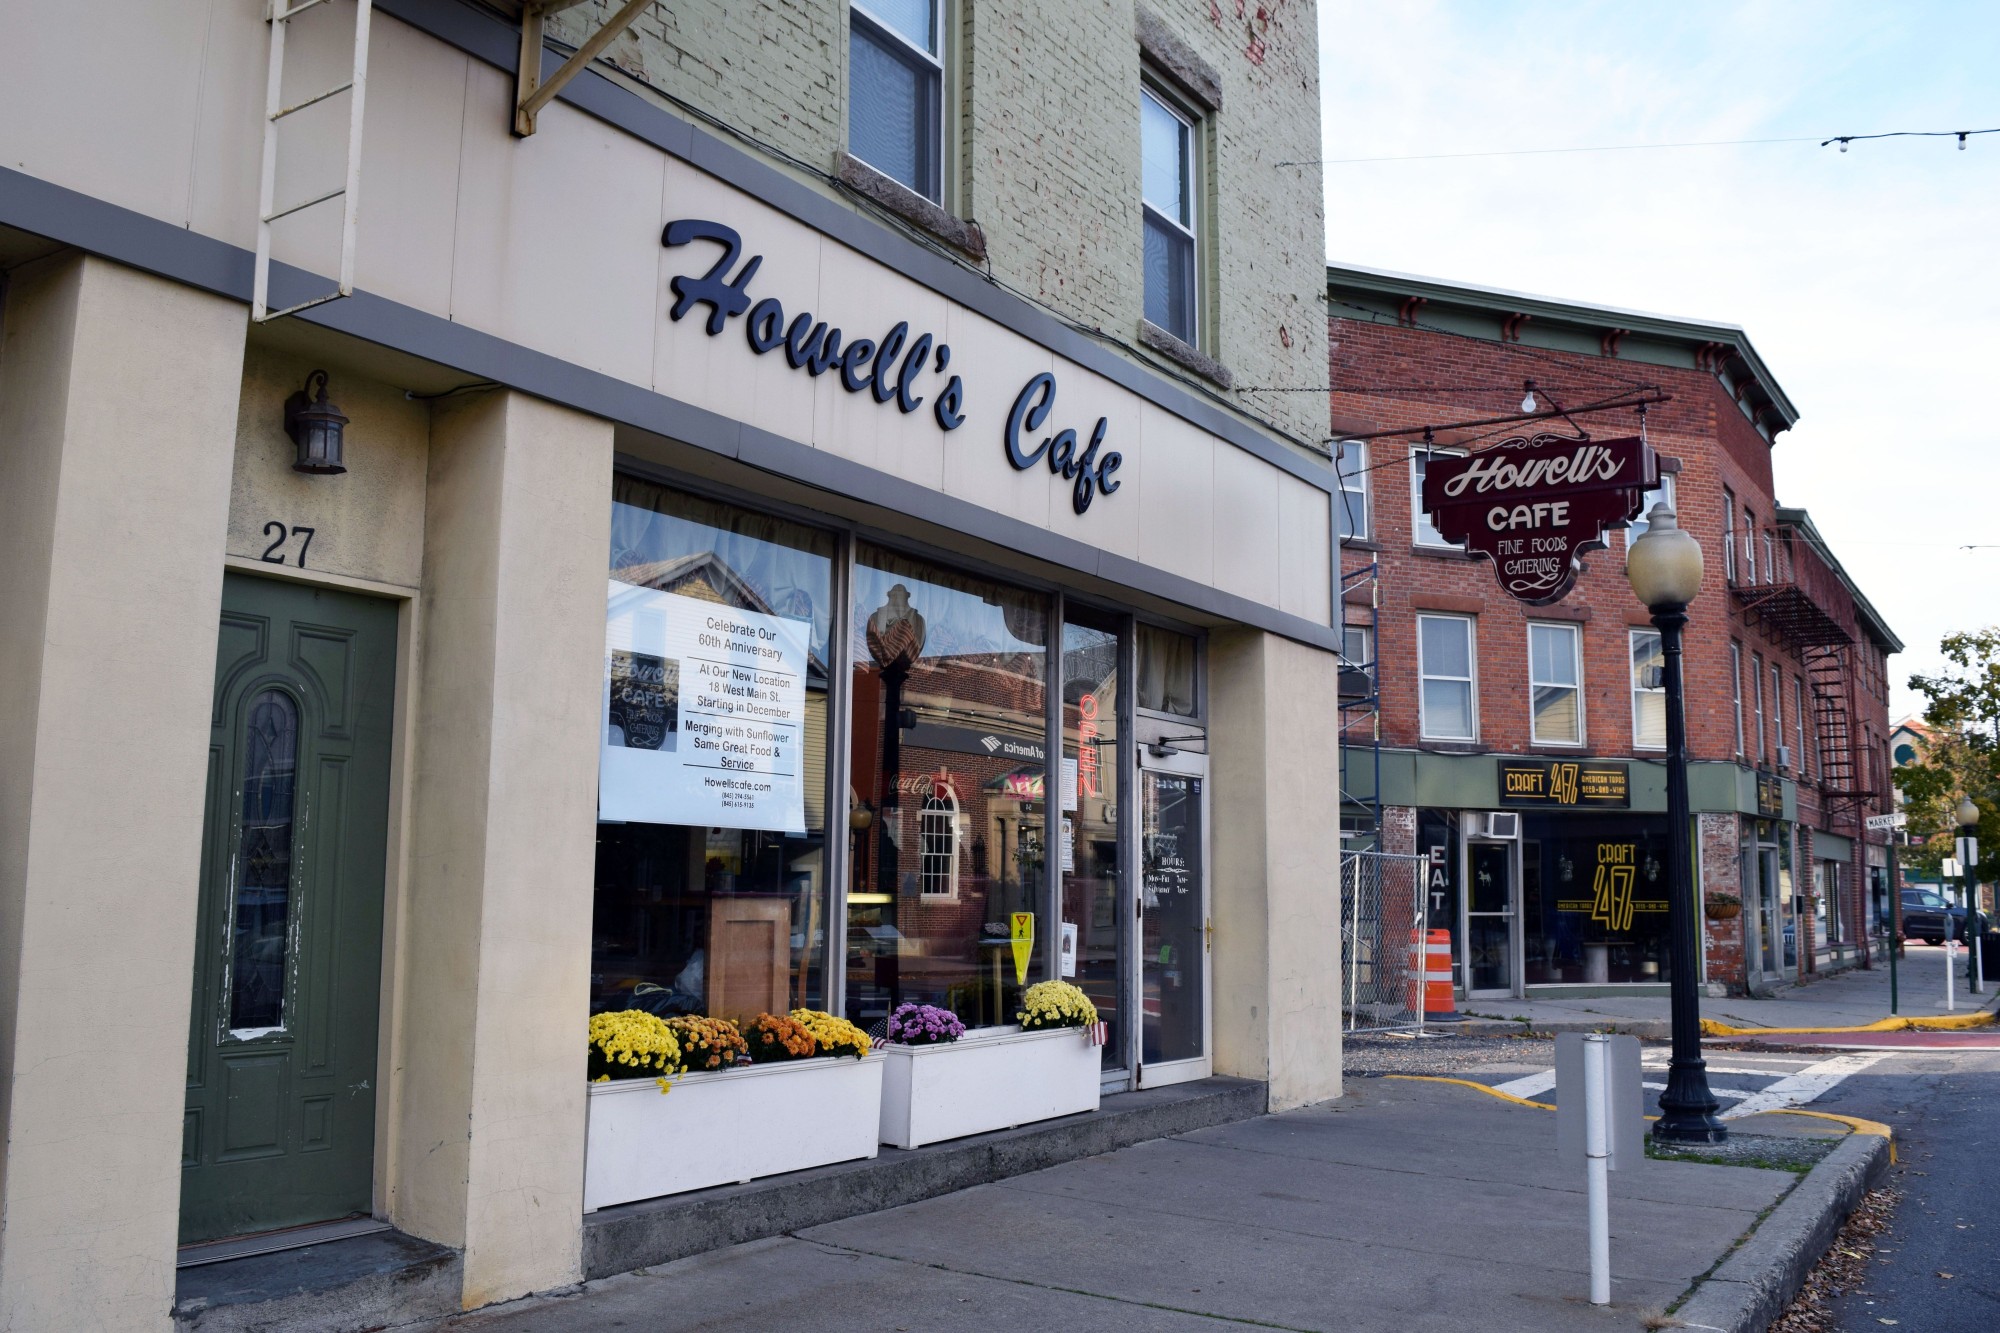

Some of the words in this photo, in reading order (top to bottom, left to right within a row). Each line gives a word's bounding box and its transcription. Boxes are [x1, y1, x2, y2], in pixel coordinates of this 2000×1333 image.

[661, 218, 966, 432] Howell's
[1004, 371, 1123, 515] Cafe
[1444, 446, 1626, 497] Howell's
[1487, 501, 1571, 531] CAFE
[262, 521, 315, 568] 27
[1498, 540, 1524, 555] FINE
[1531, 536, 1567, 552] FOODS
[1505, 557, 1561, 576] CATERING
[706, 617, 756, 637] Celebrate
[758, 627, 777, 642] Our
[698, 633, 721, 649] 60th
[724, 638, 783, 662] Anniversary
[699, 664, 710, 676] At
[712, 665, 730, 678] Our
[732, 668, 752, 682] New
[753, 673, 791, 689] Location
[621, 687, 665, 709] CAFE
[709, 682, 720, 693] 18
[722, 683, 745, 697] West
[747, 687, 767, 700] Main
[769, 691, 781, 703] St.
[697, 695, 734, 713] Starting
[736, 700, 744, 712] in
[746, 702, 791, 719] December
[685, 719, 723, 738] Merging
[725, 726, 744, 738] with
[746, 728, 790, 743] Sunflower
[694, 737, 720, 751] Same
[722, 740, 748, 754] Great
[750, 744, 772, 757] Food
[773, 747, 781, 758] &
[1078, 694, 1098, 798] OPEN
[721, 756, 754, 770] Service
[704, 777, 772, 792] Howellscafe.com
[1506, 773, 1544, 792] CRAFT
[1549, 763, 1579, 805] 47
[1161, 856, 1185, 867] HOURS:
[1597, 843, 1636, 863] CRAFT
[1430, 845, 1446, 910] EAT
[1591, 864, 1636, 931] 47
